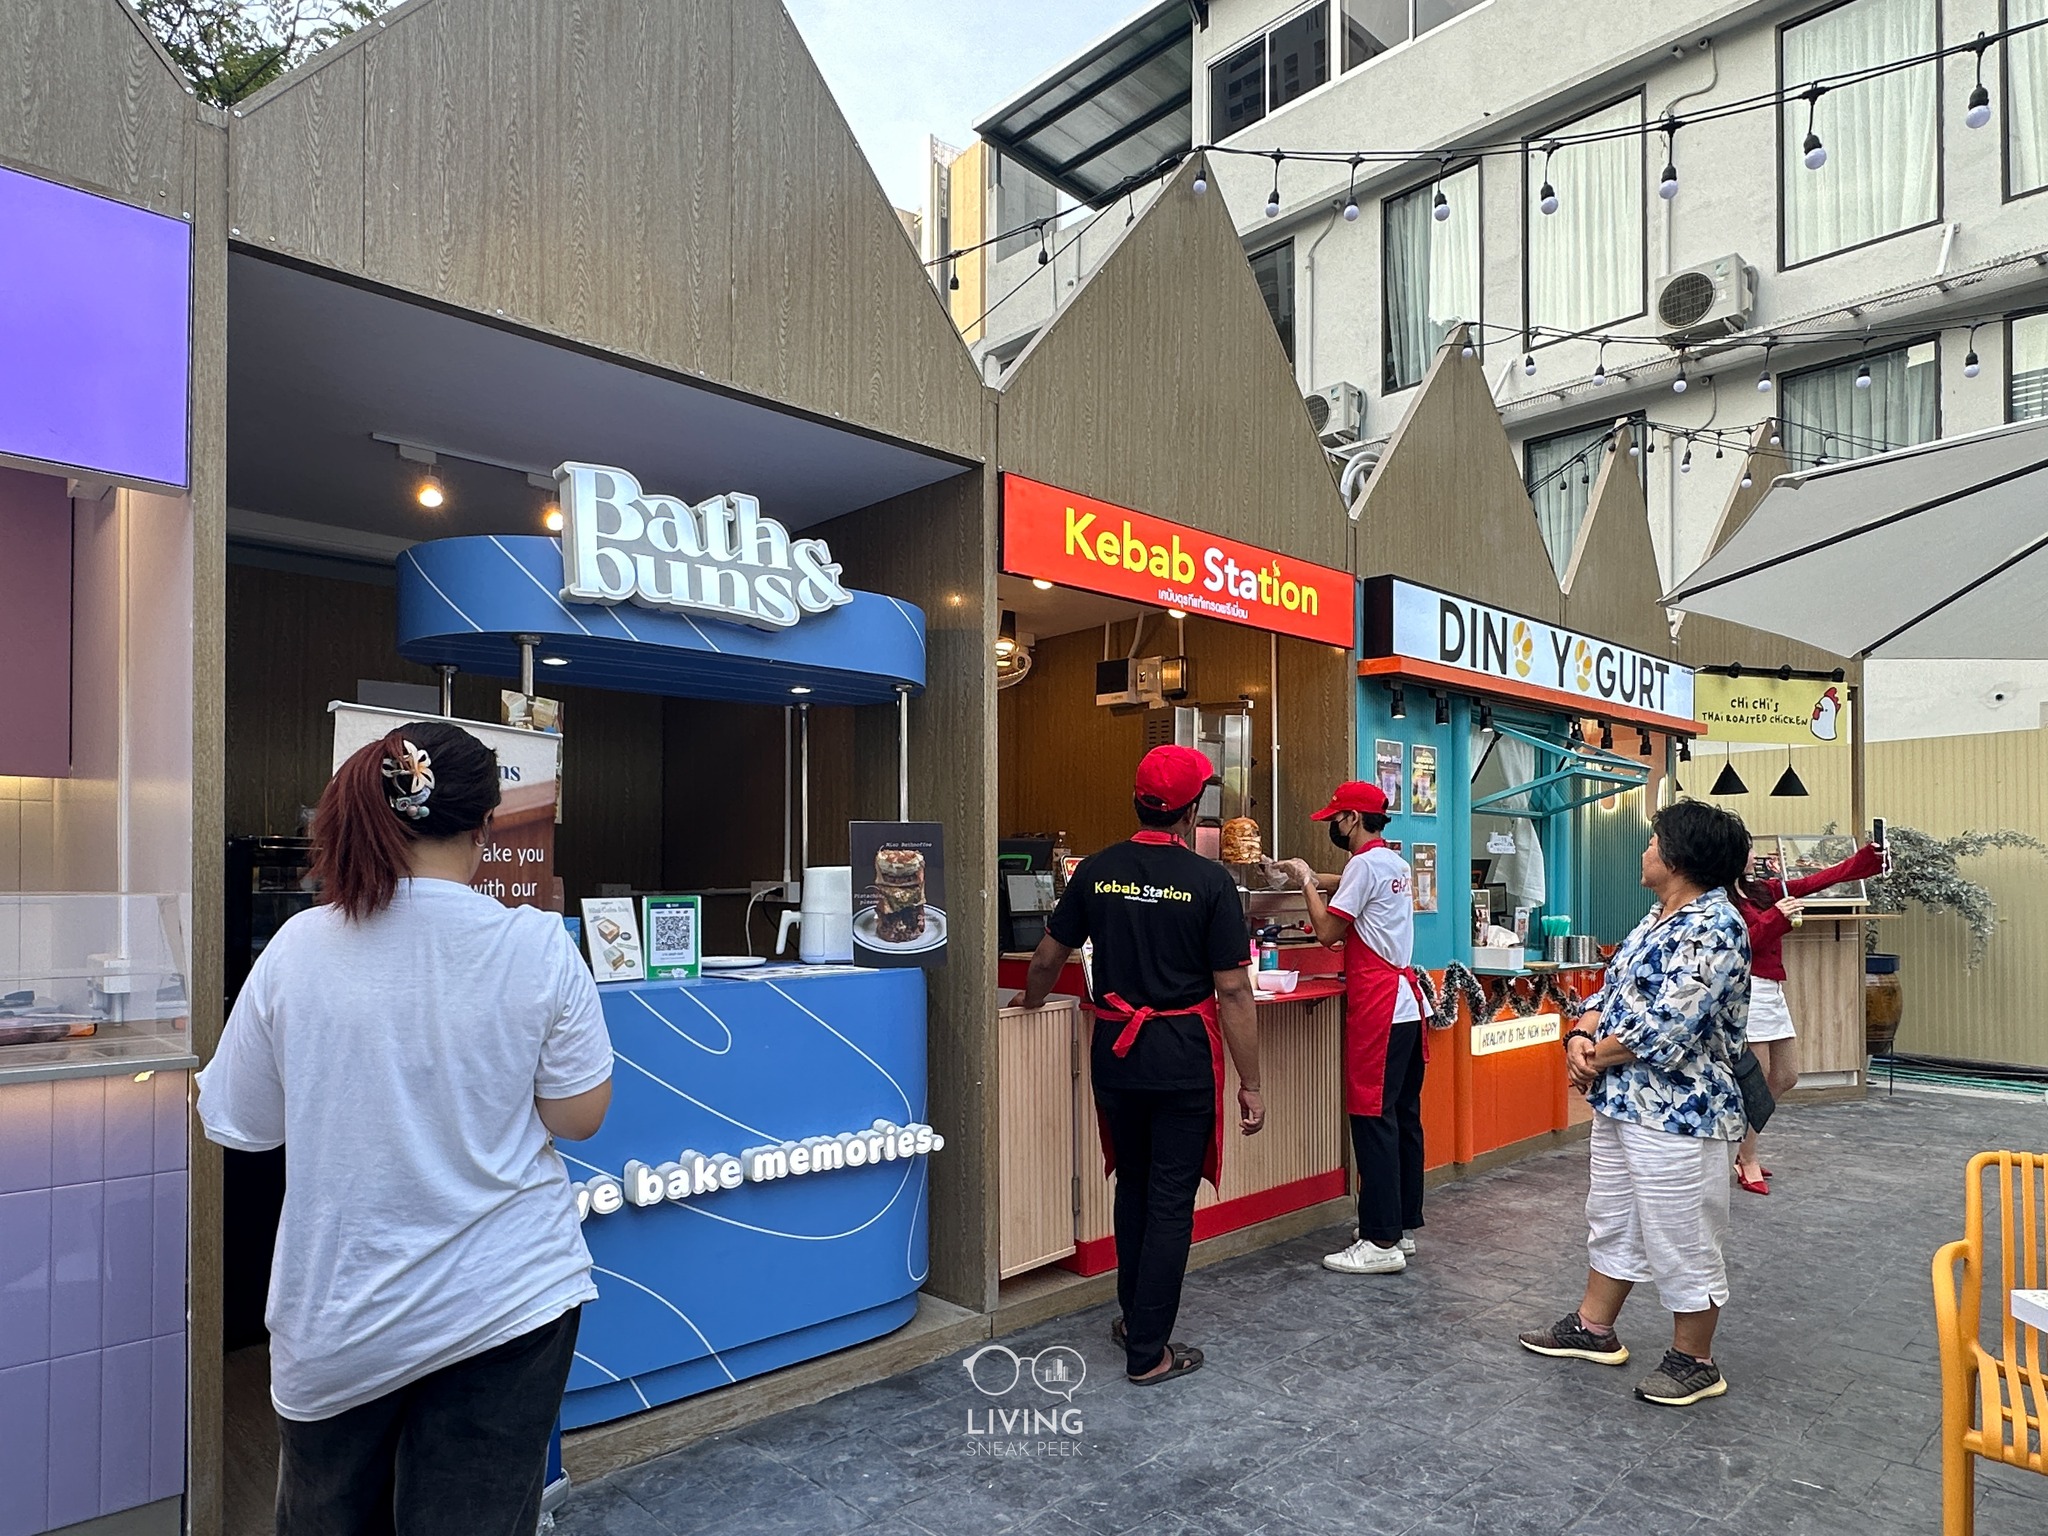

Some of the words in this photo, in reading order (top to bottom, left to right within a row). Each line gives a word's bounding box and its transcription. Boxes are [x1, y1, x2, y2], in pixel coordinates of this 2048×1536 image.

[553, 461, 793, 572] Bath
[1065, 508, 1196, 584] Kebab
[1203, 547, 1319, 616] Station
[560, 546, 801, 632] buns
[1725, 712, 1767, 724] ROASTED
[482, 842, 513, 863] ake
[516, 847, 544, 867] you
[511, 882, 538, 897] our
[1094, 879, 1141, 895] Kebab
[1142, 885, 1192, 903] Station
[1482, 1029, 1507, 1048] HEALTHY
[1508, 1030, 1514, 1043] IS
[1516, 1027, 1527, 1041] THE
[1527, 1025, 1540, 1039] NEW
[1540, 1022, 1558, 1037] HAPPY
[623, 1148, 744, 1207] bake
[741, 1118, 945, 1184] memories.
